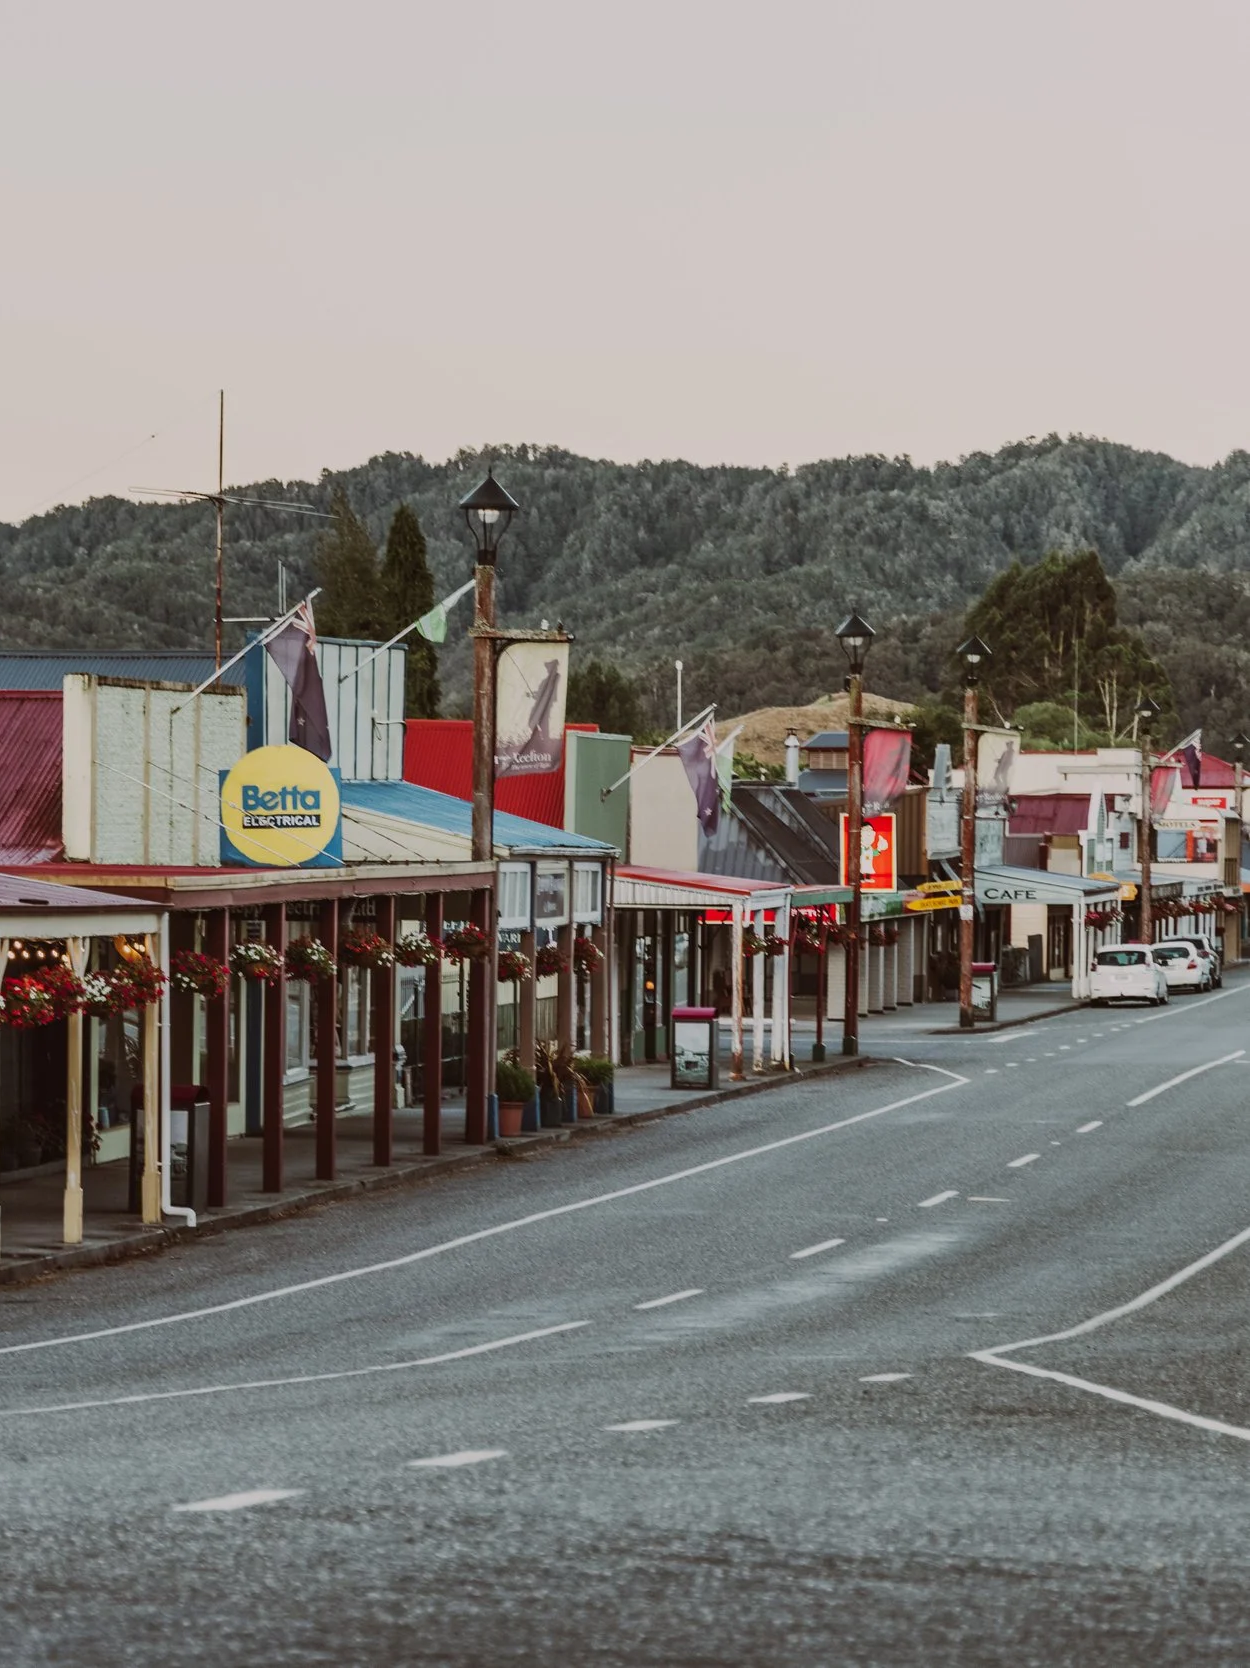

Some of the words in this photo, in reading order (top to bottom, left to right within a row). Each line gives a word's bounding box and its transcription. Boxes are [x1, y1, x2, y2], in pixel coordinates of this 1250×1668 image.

[242, 785, 321, 811] Betta
[243, 815, 320, 827] ELECTRICAL
[983, 888, 1038, 900] CAFE
